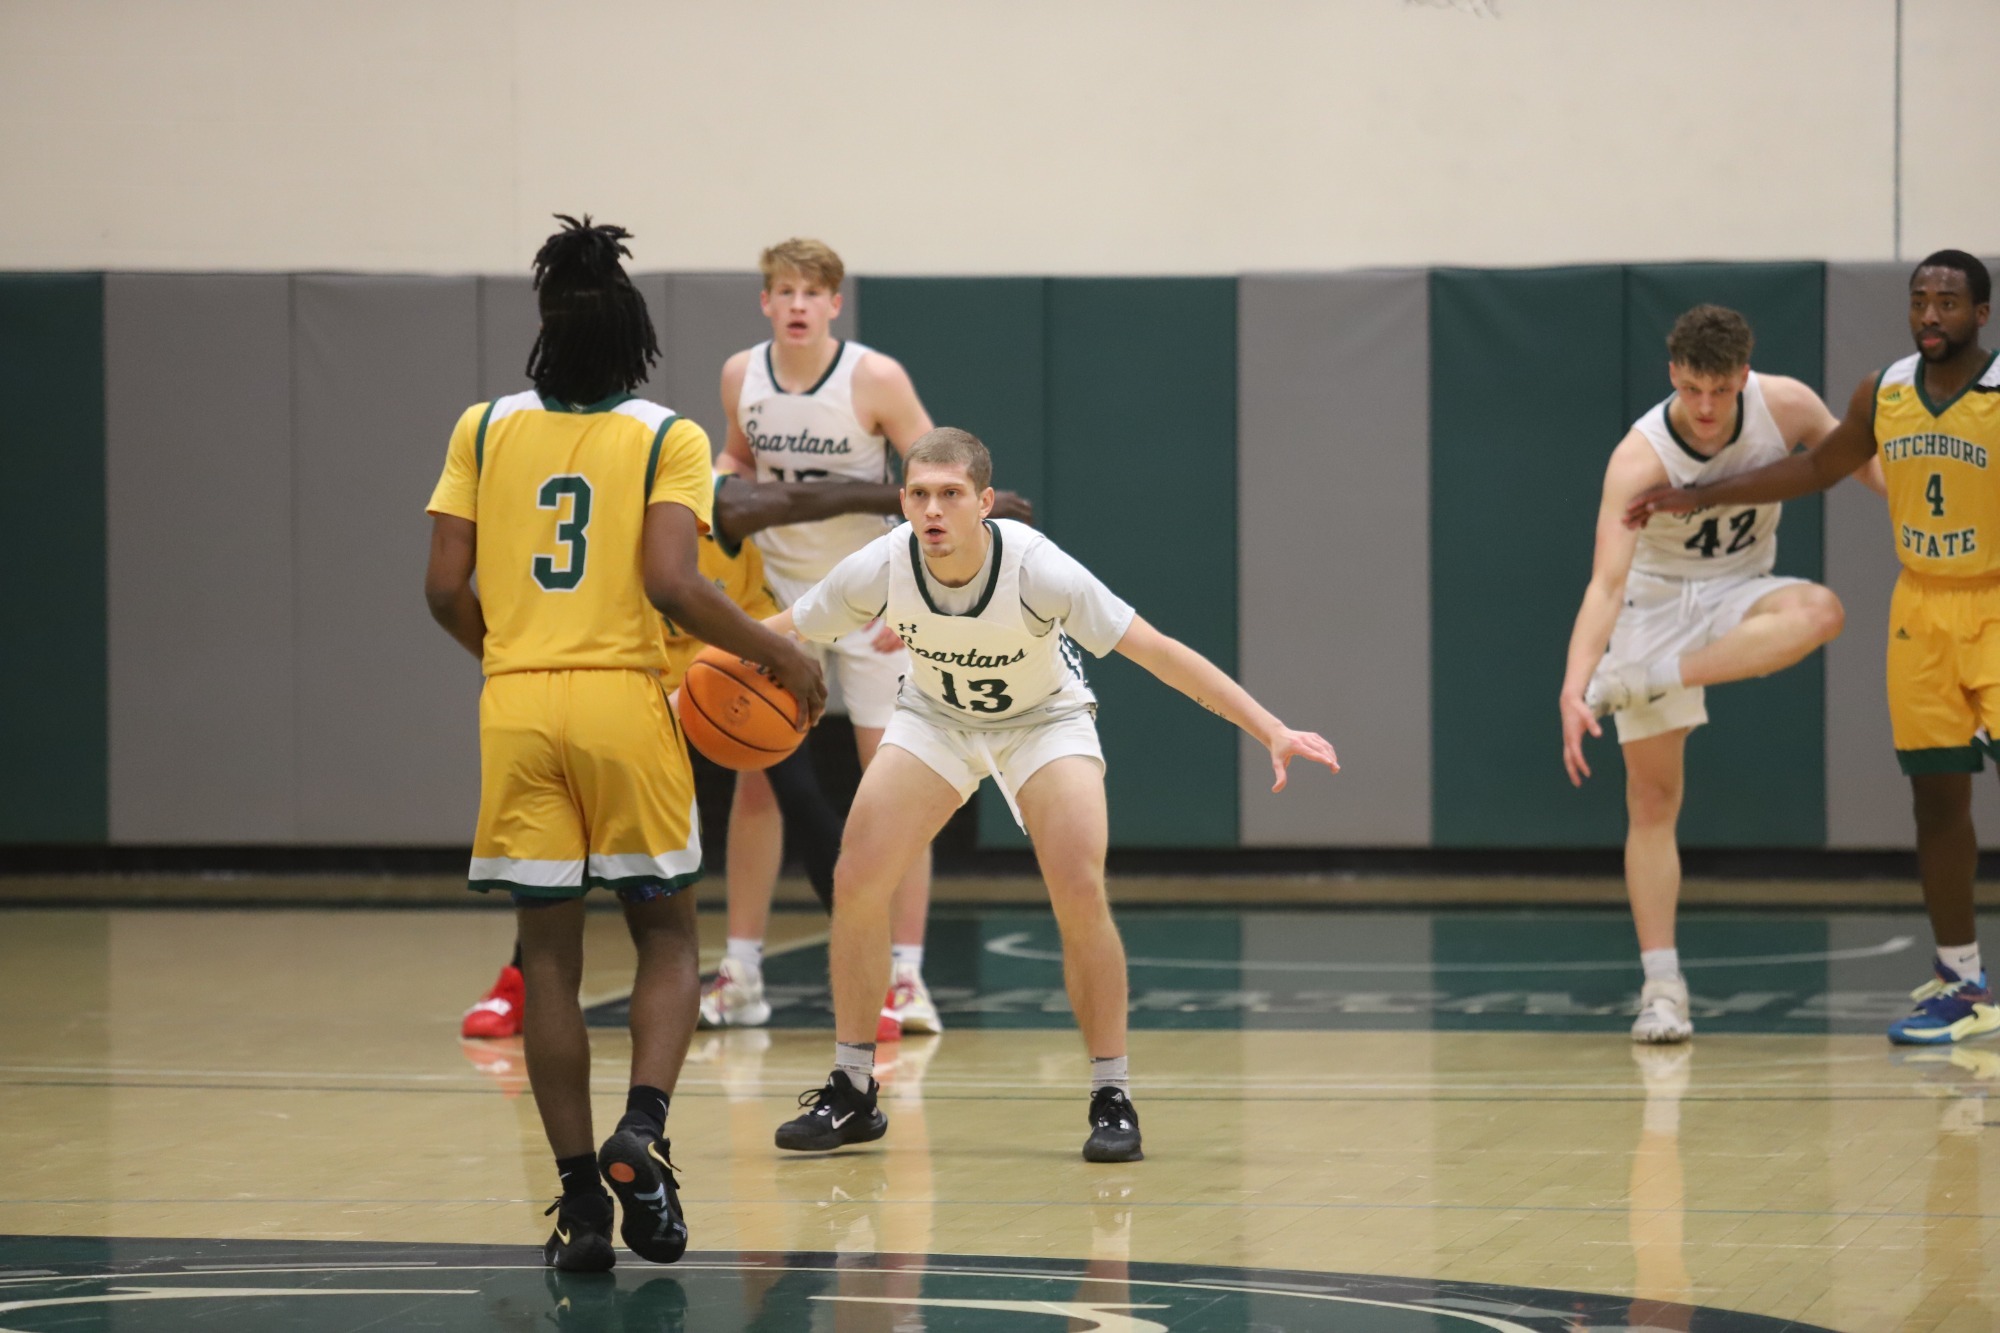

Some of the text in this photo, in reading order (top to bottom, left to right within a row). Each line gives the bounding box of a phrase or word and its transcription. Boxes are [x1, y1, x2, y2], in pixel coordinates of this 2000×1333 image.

[746, 420, 852, 457] Spartans
[1883, 431, 1988, 469] FITCHBURG
[1924, 472, 1946, 518] 4
[530, 472, 594, 593] 3
[1684, 508, 1757, 558] 42
[1901, 523, 1977, 559] STATE
[931, 665, 1014, 714] 13
